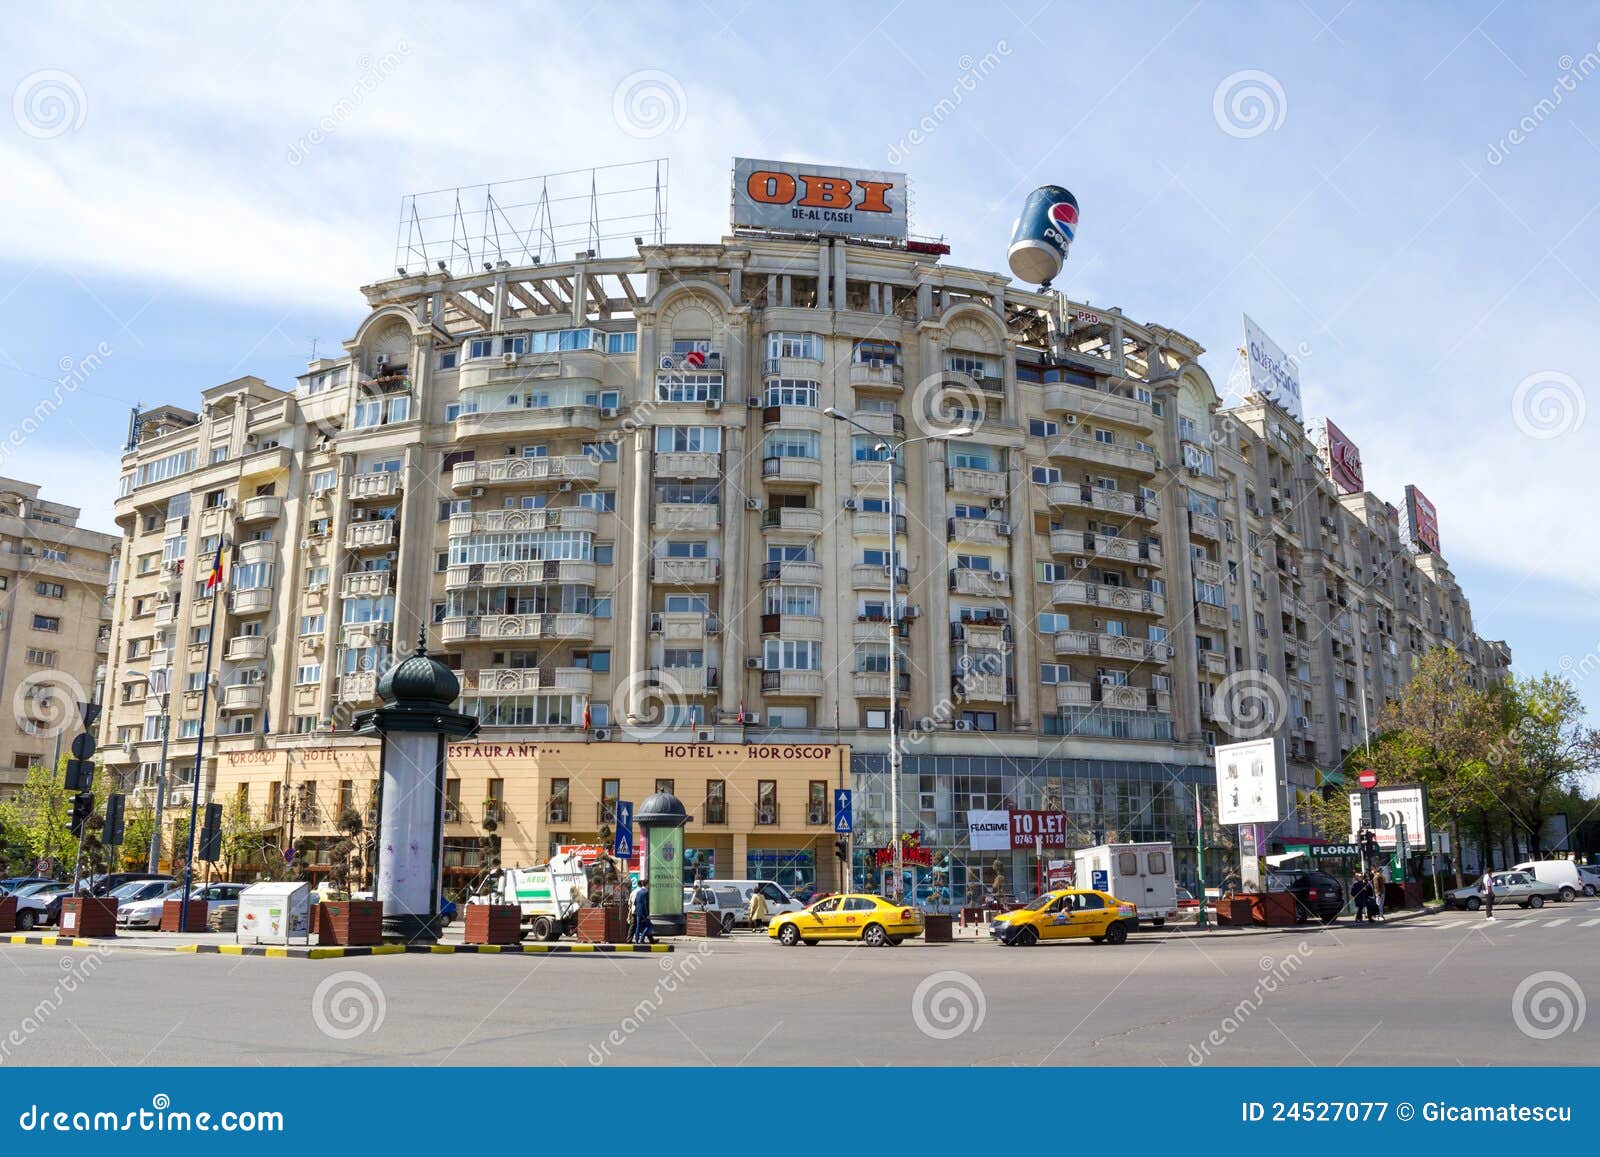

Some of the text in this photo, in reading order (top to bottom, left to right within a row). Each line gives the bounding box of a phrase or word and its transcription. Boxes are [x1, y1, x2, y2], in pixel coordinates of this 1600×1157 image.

[747, 170, 894, 213] OBI
[792, 208, 853, 223] DE-AL CASEI
[303, 749, 338, 761] HOTEL
[448, 745, 537, 757] ESTAURANT
[664, 746, 832, 759] HOTEL HOROSCOP
[227, 752, 277, 765] HOROSCOP
[1013, 814, 1064, 833] TO LET
[1093, 871, 1102, 885] P
